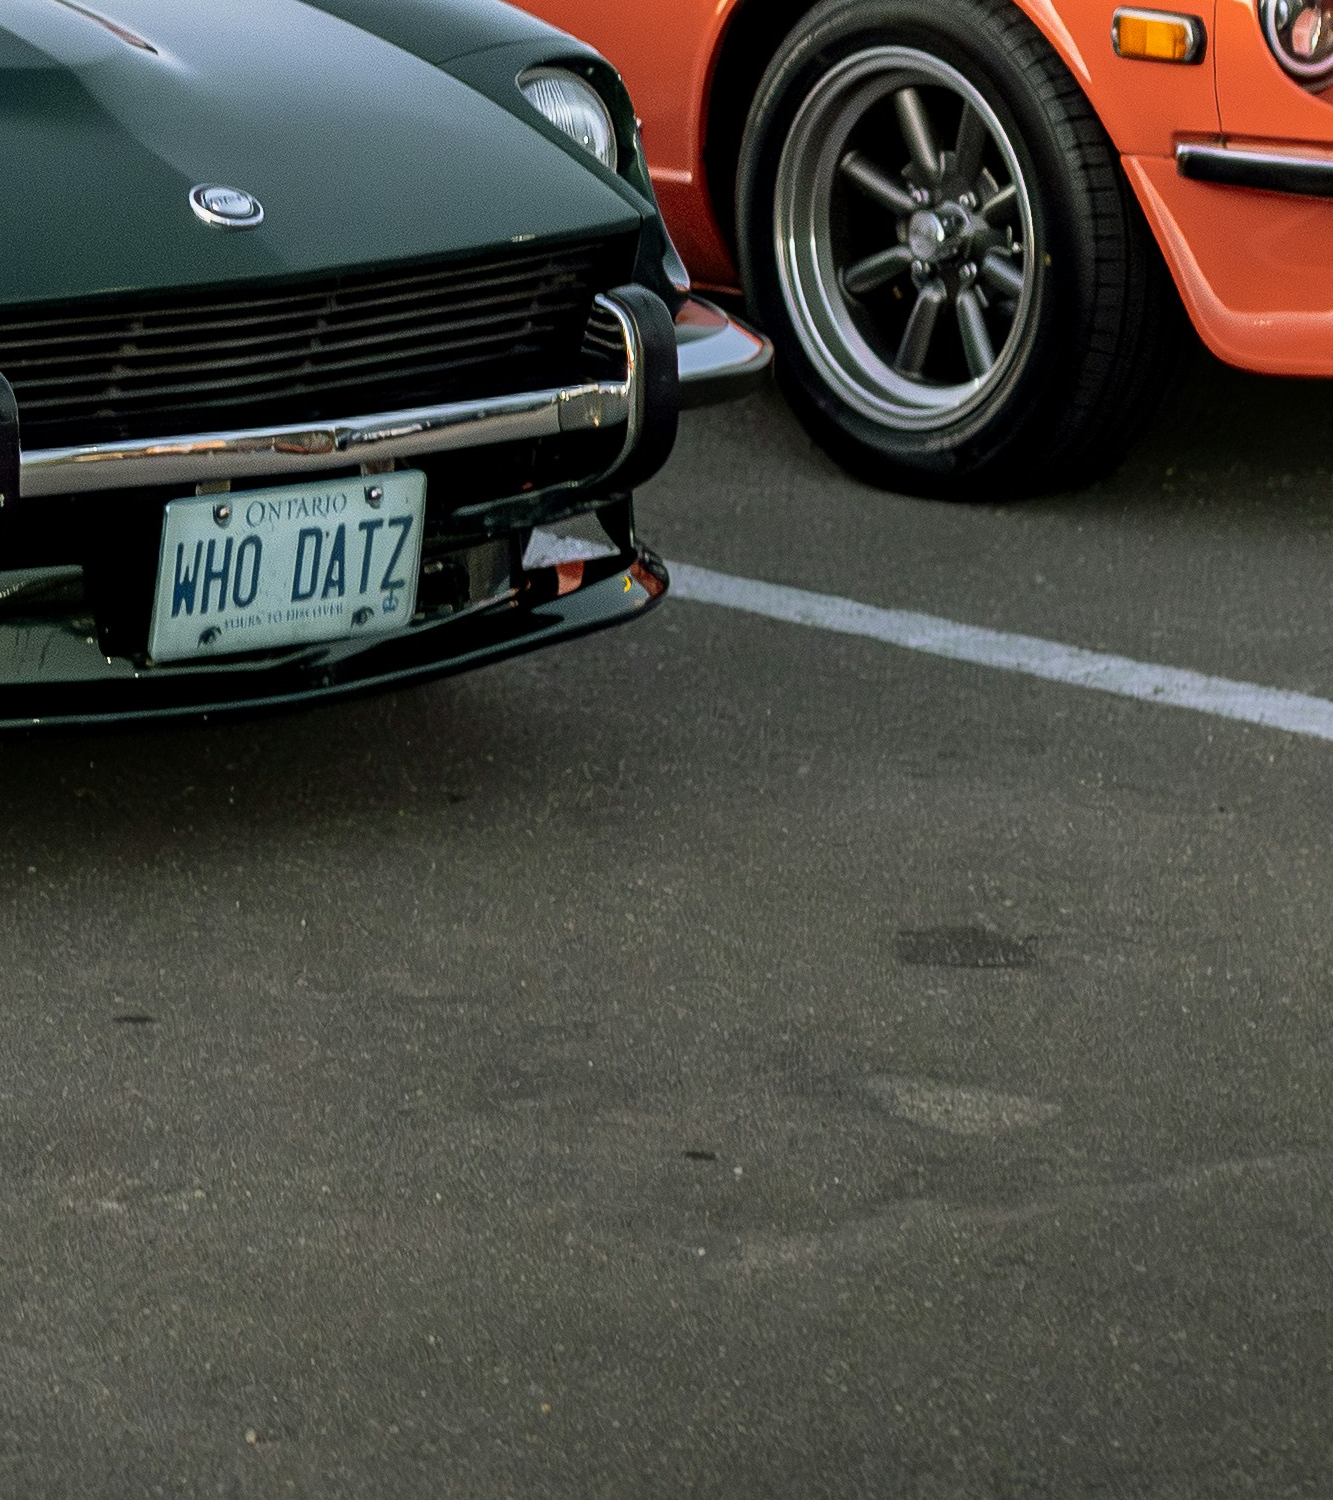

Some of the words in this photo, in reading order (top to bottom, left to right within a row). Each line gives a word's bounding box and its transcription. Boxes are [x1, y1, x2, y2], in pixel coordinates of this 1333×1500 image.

[246, 493, 347, 528] ONTARIO
[171, 533, 264, 620] WHO
[290, 515, 414, 603] DATZ
